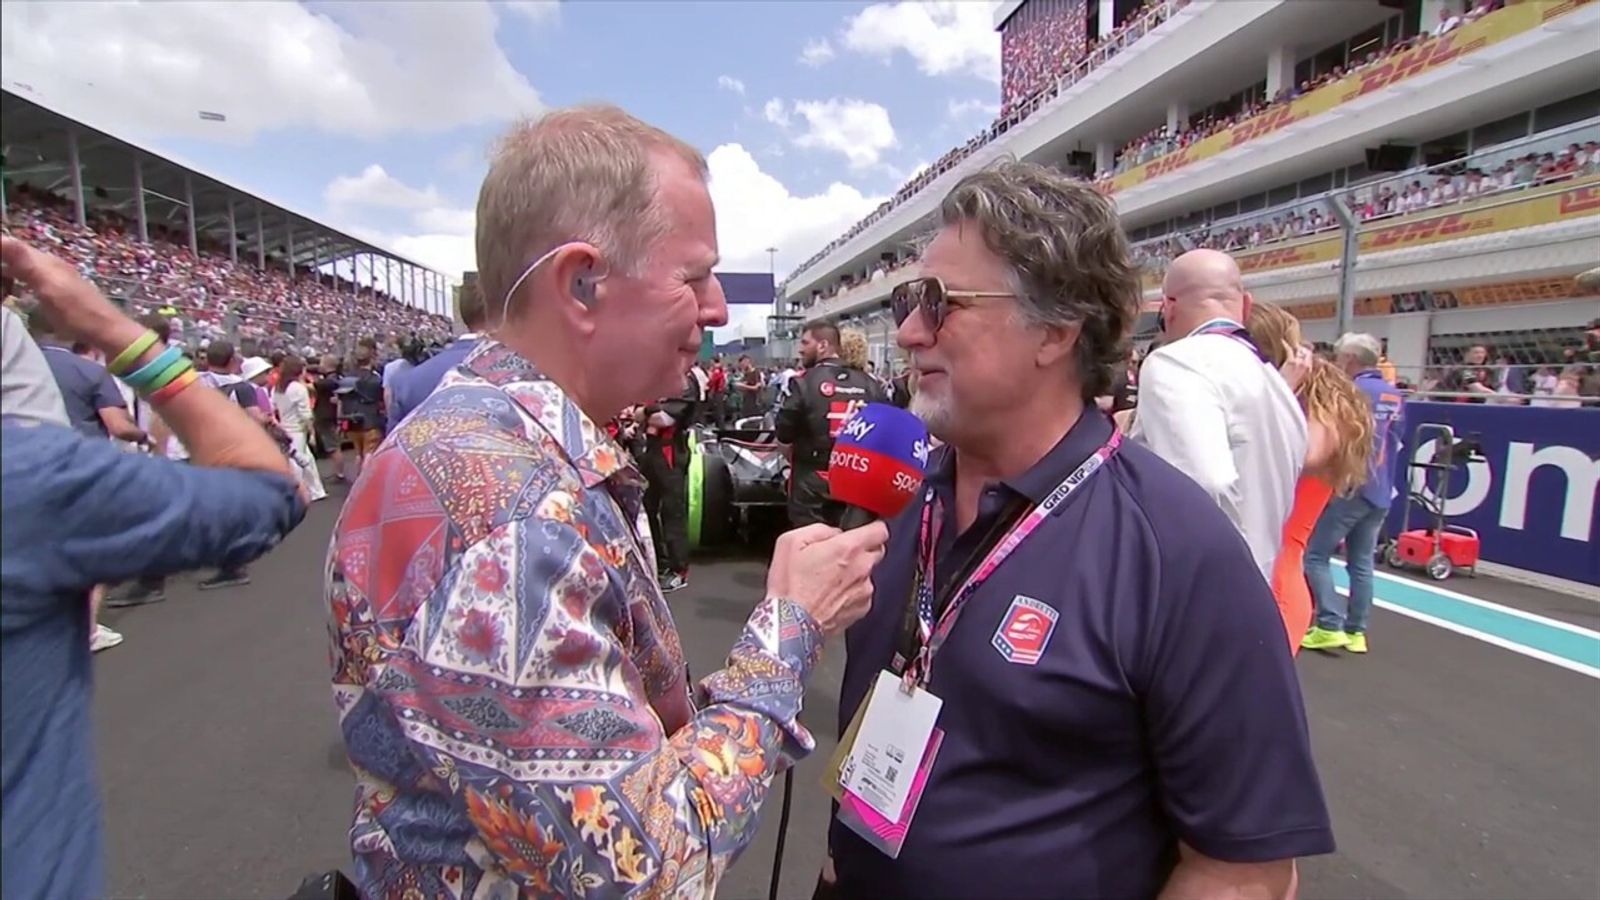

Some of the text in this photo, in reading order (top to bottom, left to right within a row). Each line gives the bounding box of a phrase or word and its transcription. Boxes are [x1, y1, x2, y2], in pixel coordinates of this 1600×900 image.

[1359, 35, 1461, 94] DHL
[1231, 105, 1296, 147] DHL
[1144, 149, 1190, 180] DHL
[1371, 214, 1473, 247] DHL
[843, 416, 876, 441] sky
[1042, 467, 1085, 510] GRID VIP
[1391, 436, 1600, 542] om
